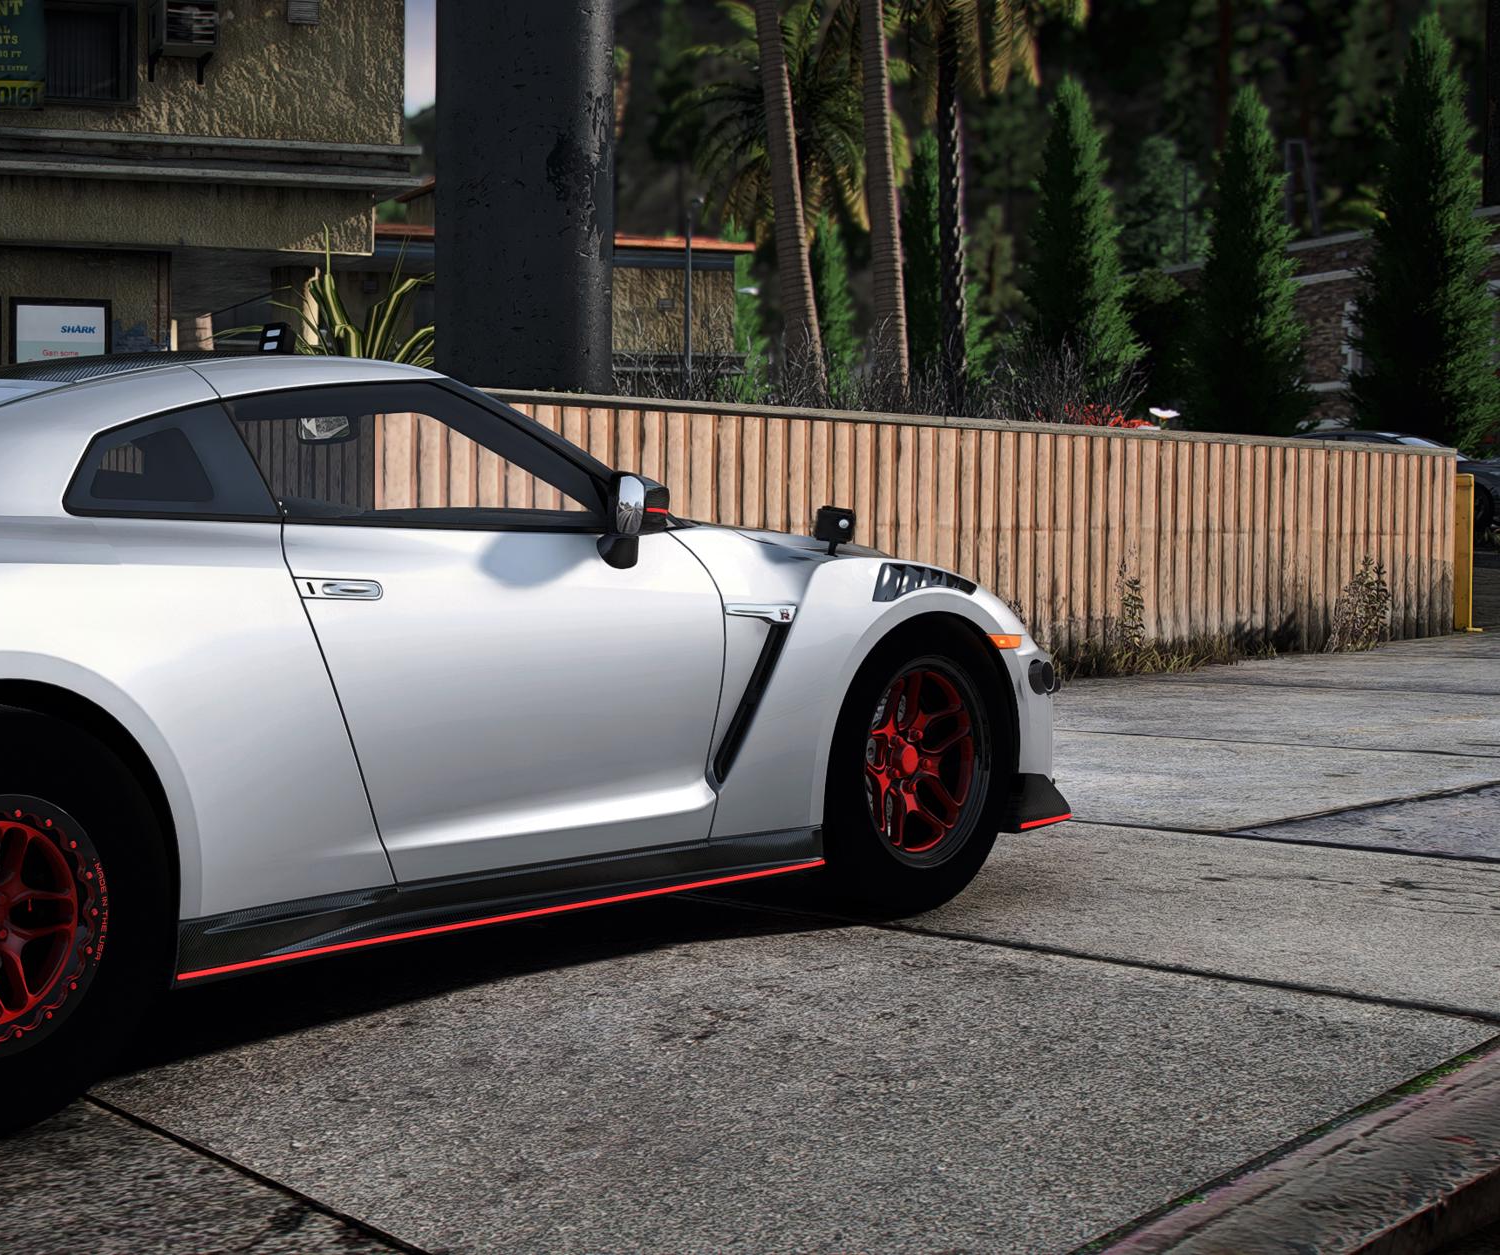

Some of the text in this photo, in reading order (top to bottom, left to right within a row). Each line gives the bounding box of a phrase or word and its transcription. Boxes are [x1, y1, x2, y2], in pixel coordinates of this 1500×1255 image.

[60, 325, 96, 334] SHARK
[94, 862, 107, 894] MADE
[101, 896, 108, 907] IN
[100, 909, 109, 932] THE
